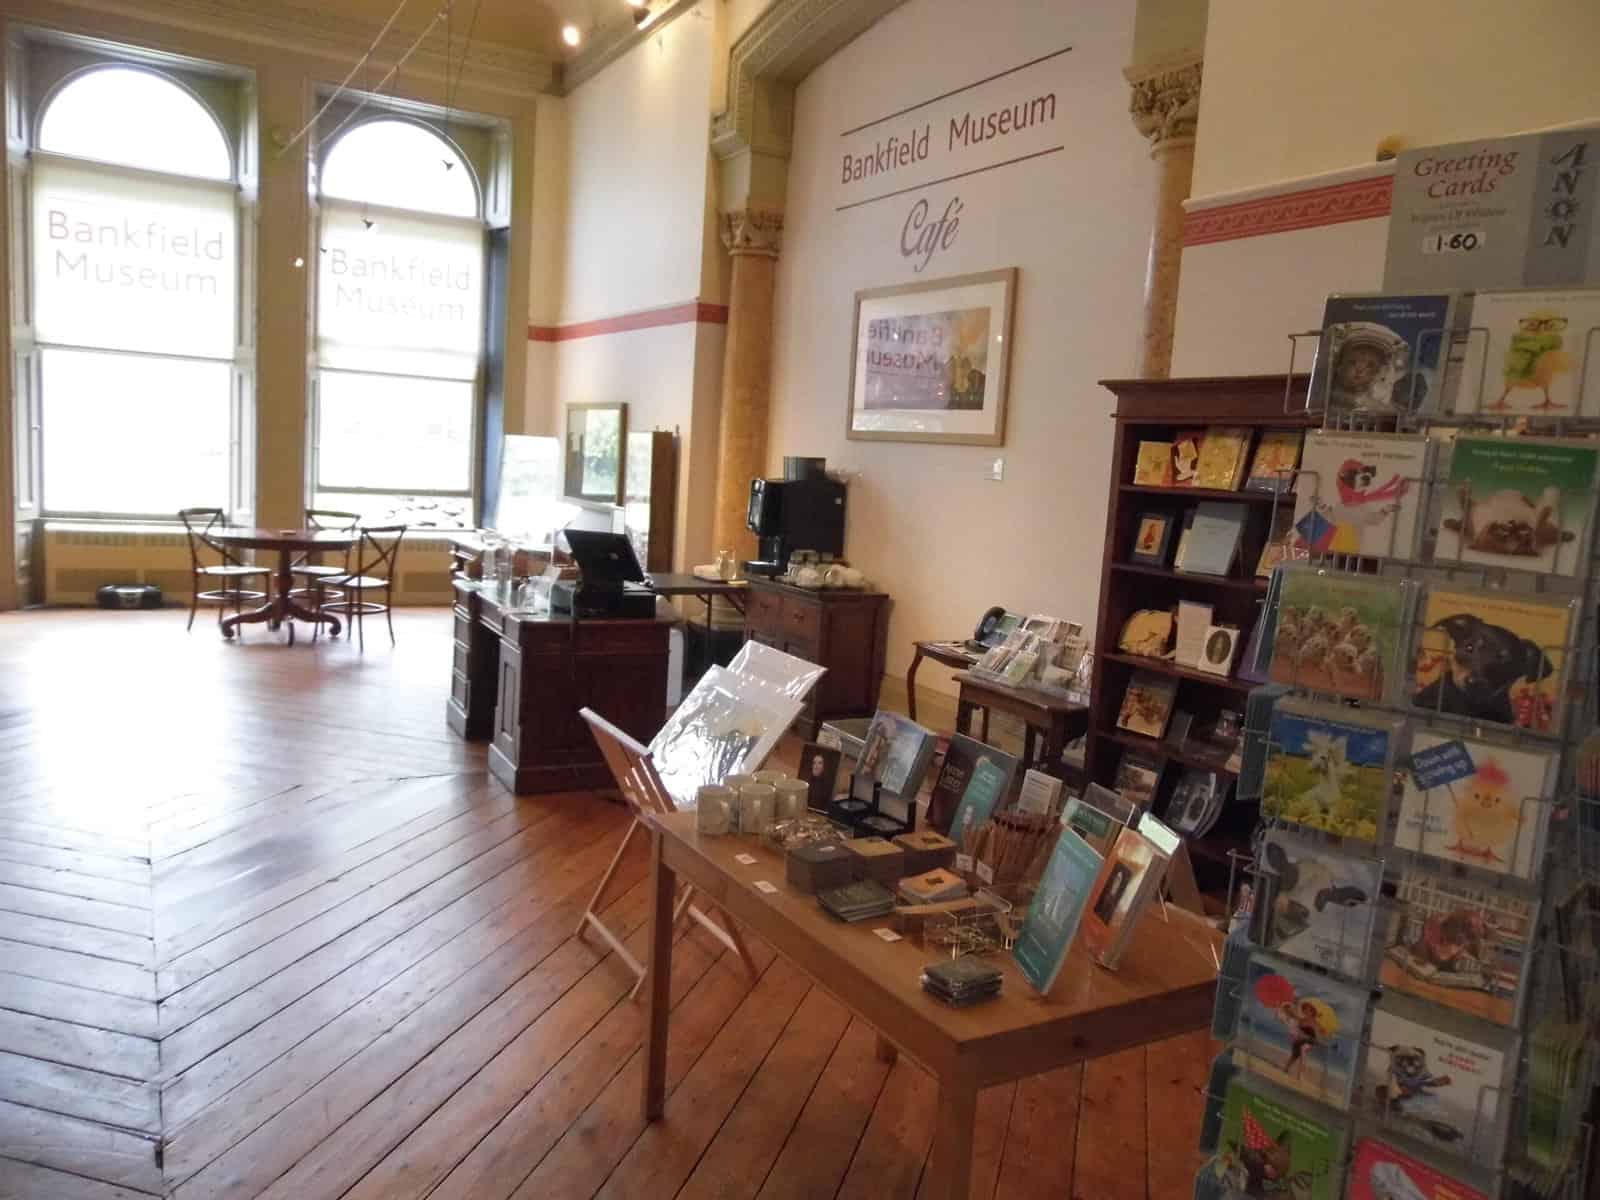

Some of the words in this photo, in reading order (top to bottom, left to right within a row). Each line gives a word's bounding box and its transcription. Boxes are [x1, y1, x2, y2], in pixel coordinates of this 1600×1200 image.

[841, 124, 931, 184] Bankfield
[949, 92, 1057, 152] Museum
[1413, 147, 1520, 177] Greeting
[1427, 171, 1497, 199] Cards
[48, 209, 224, 261] Bankfield
[900, 196, 964, 273] Café
[1436, 233, 1478, 251] 1.60
[55, 248, 218, 296] Museum
[331, 247, 471, 292] Bankfield
[335, 283, 465, 322] Museum
